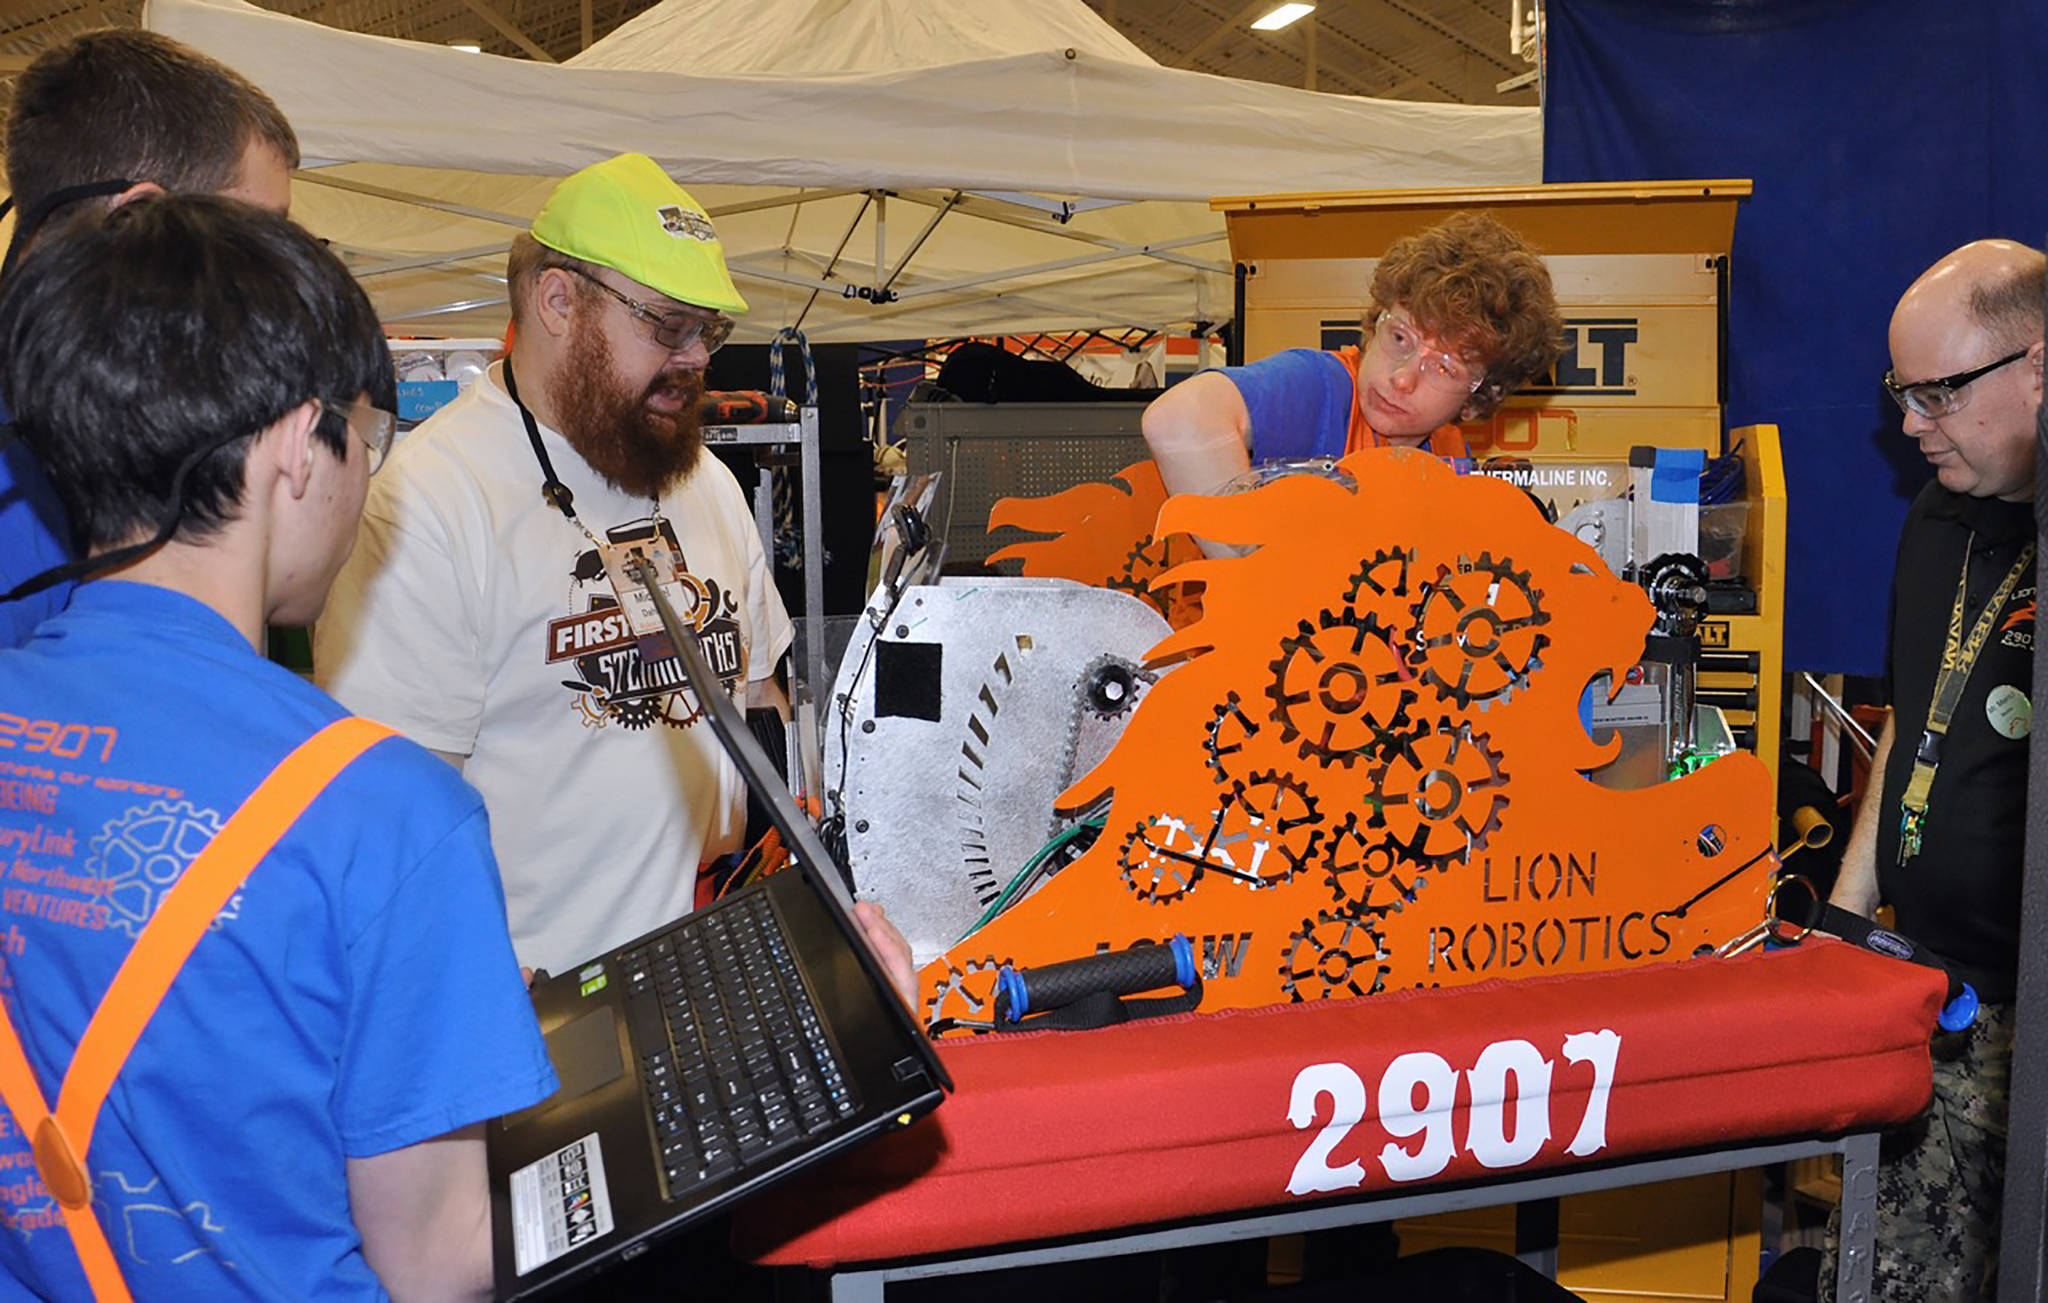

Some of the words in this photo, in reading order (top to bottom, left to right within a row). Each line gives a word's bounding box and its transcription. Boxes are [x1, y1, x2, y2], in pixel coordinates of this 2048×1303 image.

[1580, 470, 1613, 487] INC.
[556, 614, 630, 654] FIRST
[2004, 629, 2032, 645] 290
[0, 713, 118, 763] 2907
[1482, 850, 1597, 904] LION
[4, 887, 111, 932] VENTURES
[1428, 910, 1672, 974] ROBOTICS
[1285, 1028, 1622, 1196] 2907
